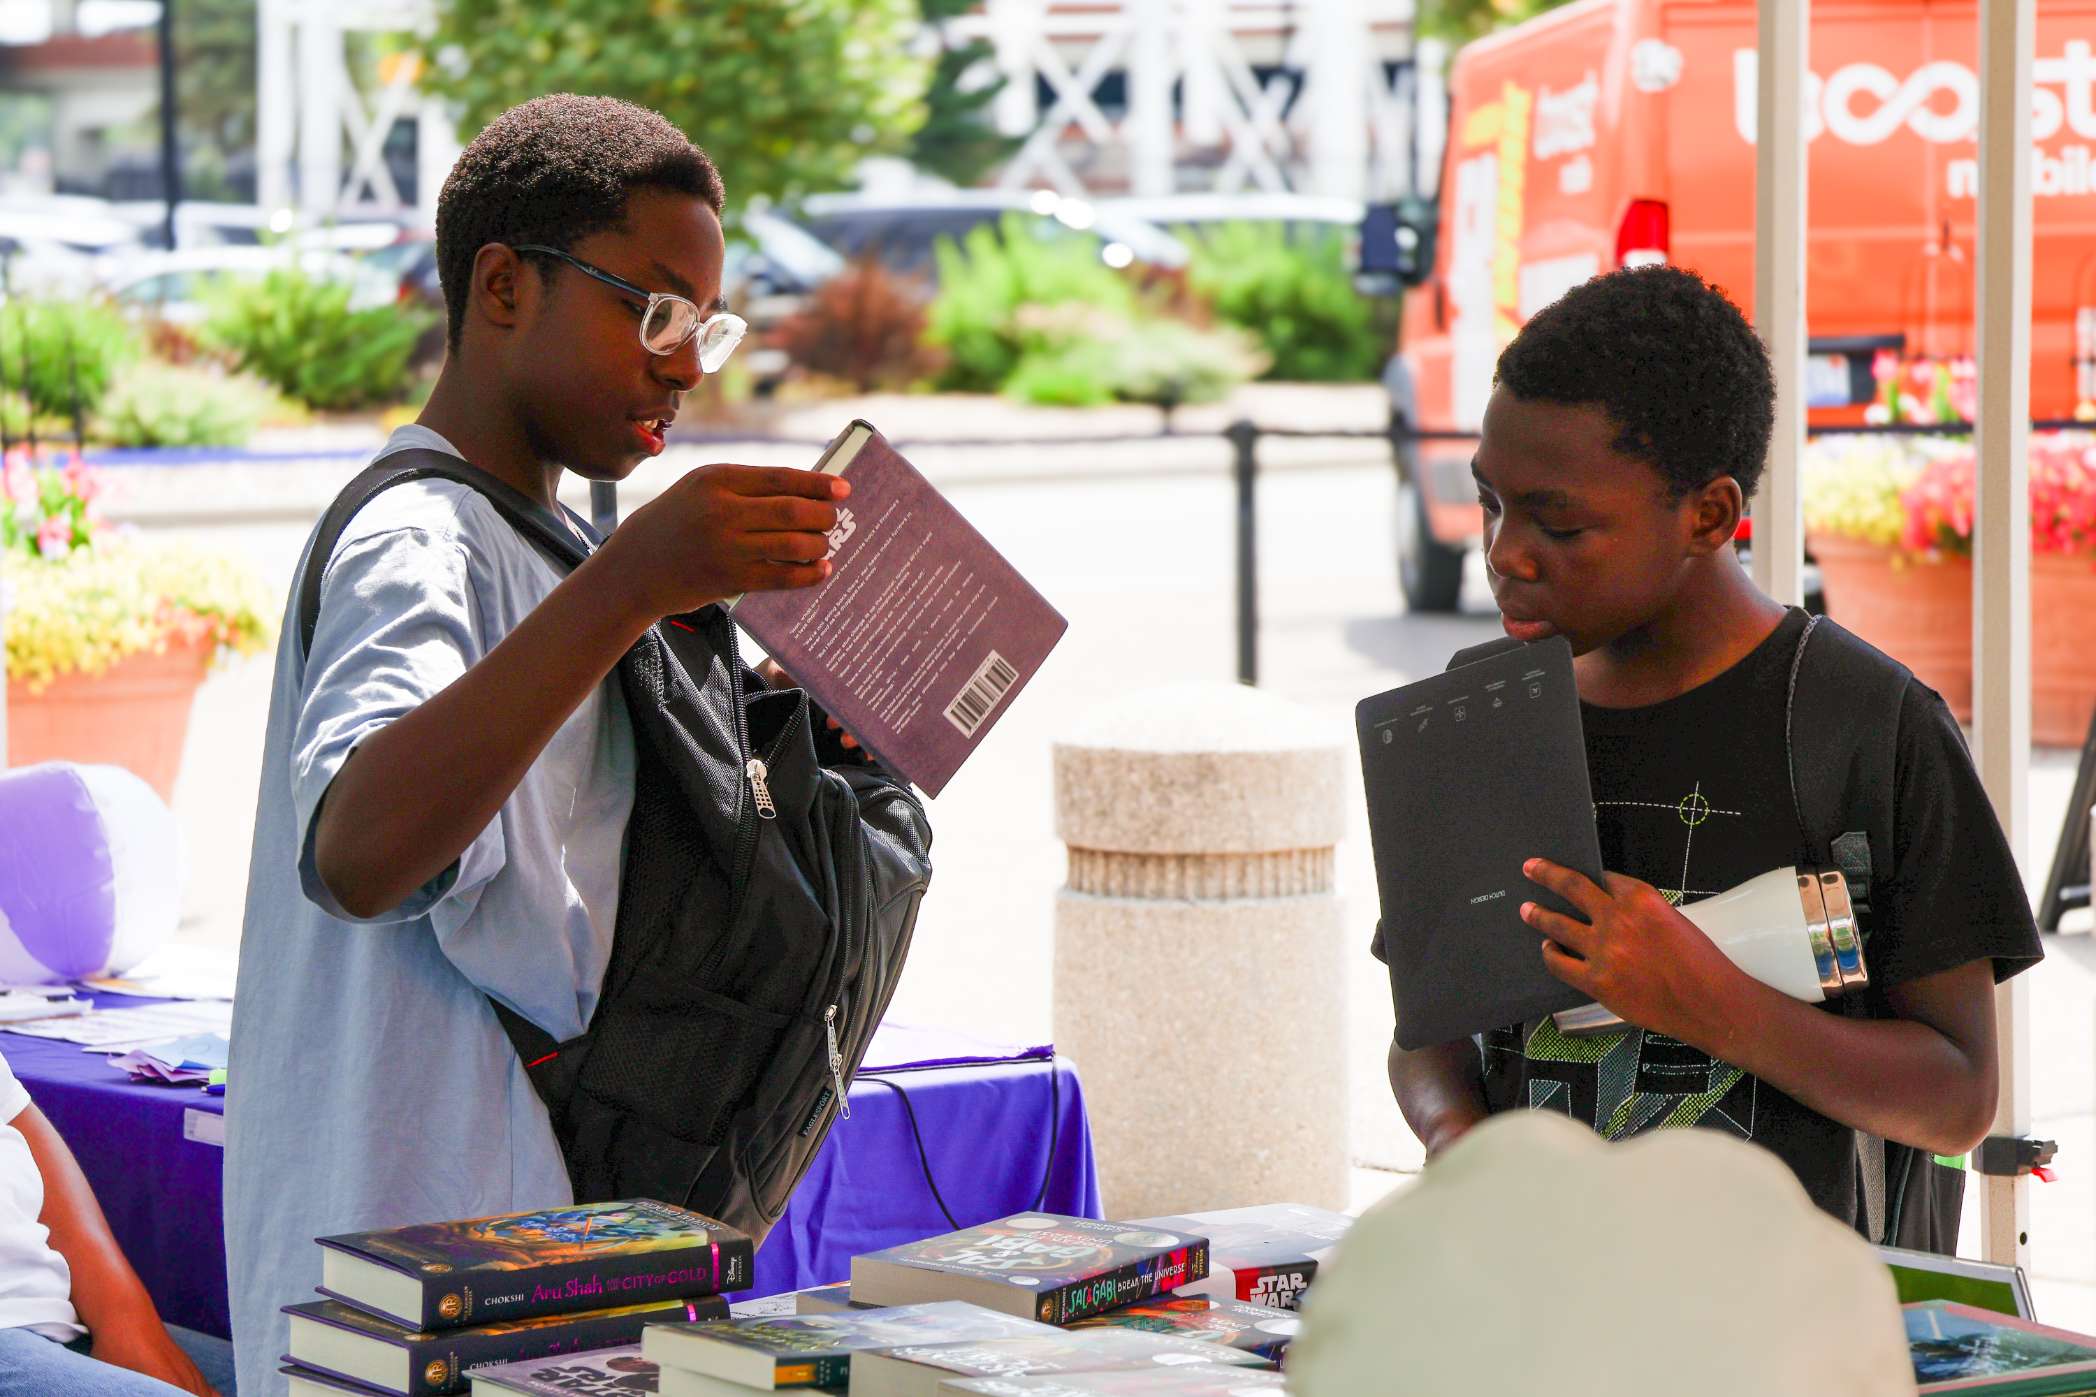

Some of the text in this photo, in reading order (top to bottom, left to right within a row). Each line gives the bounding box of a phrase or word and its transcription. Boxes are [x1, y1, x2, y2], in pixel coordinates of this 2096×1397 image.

[1947, 144, 2096, 198] mbil
[820, 511, 856, 561] RS
[485, 1294, 524, 1306] CHOKSHI
[531, 1283, 562, 1303] Aru
[565, 1273, 603, 1298] Shah
[622, 1271, 656, 1291] CITY
[667, 1267, 708, 1285] GOLD
[1092, 1277, 1117, 1305] GABI
[1117, 1277, 1140, 1293] BREAK
[1141, 1273, 1153, 1285] THE
[1154, 1263, 1186, 1280] UNIVERSE
[1250, 1272, 1308, 1295] STAR
[1250, 1290, 1297, 1311] WAR
